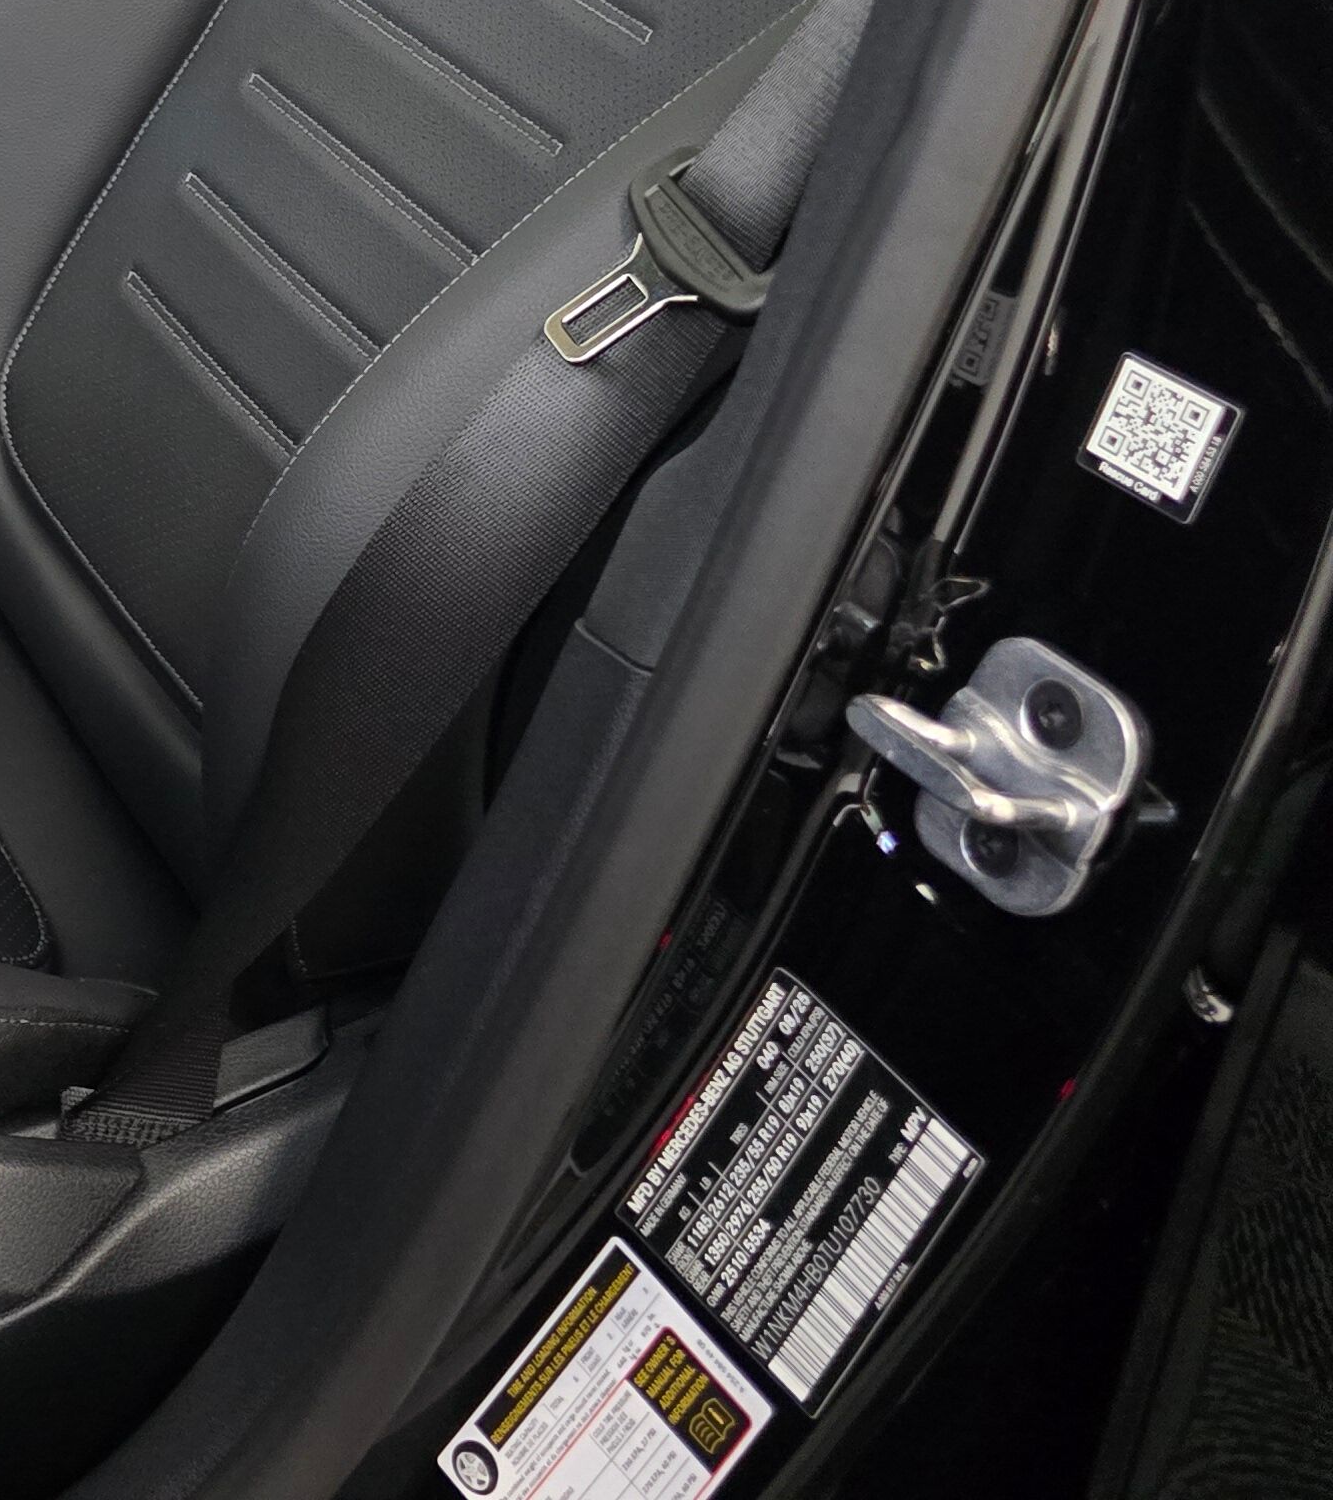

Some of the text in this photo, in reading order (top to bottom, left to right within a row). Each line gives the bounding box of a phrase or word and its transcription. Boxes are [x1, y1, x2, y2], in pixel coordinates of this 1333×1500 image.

[1097, 460, 1158, 502] Rescue Card
[754, 1037, 781, 1072] 040
[626, 980, 788, 1216] MFD BY MERCEDES-BENZ AG STUTTGART
[677, 1203, 692, 1222] KG
[729, 1120, 749, 1146] TIRES
[763, 1075, 779, 1095] RIM
[772, 1060, 789, 1081] SIZE
[786, 1033, 807, 1060] COLD
[685, 1211, 714, 1249] 1185
[706, 1180, 735, 1219] 2612
[727, 1135, 767, 1189] 235/55
[756, 1112, 782, 1144] R19
[801, 1018, 845, 1076] 250(37)
[703, 1229, 732, 1268] 1350
[723, 1198, 753, 1237] 2976
[744, 1153, 785, 1207] 255/50
[774, 1129, 799, 1162] R19
[819, 1036, 863, 1093] 270(40)
[653, 1203, 665, 1218] IN
[658, 1170, 688, 1210] GERMANY
[720, 1088, 880, 1324] THIS VEHICLE CONFORMS TO ALL APPLICABLE FEDERAL MOTOR VEHICLE
[729, 1302, 753, 1334] SAFETY
[745, 1286, 763, 1309] AND
[756, 1266, 777, 1293] THEFT
[769, 1224, 804, 1273] PREVENTION
[829, 1150, 854, 1182] EFFECT
[846, 1139, 861, 1158] ON
[854, 1125, 871, 1146] THE
[863, 1107, 883, 1132] DATE
[875, 1096, 890, 1114] OF
[638, 1210, 660, 1239] MADE
[719, 1247, 749, 1288] 2510
[741, 1214, 772, 1255] 5534
[750, 1172, 883, 1363] W1NKM4HB0TU107730
[899, 1104, 929, 1142] MPV
[691, 1268, 711, 1294] REAR
[489, 1261, 636, 1446] RENSEIGNEMENTS SUR LES PNEUS ET LE CHARGEMENT
[506, 1284, 598, 1399] TIRE AND LOADING INFORMATION
[645, 1346, 687, 1399] MANUAL FOR
[632, 1367, 650, 1388] SEE
[657, 1362, 696, 1411] ADDITIONAL
[666, 1371, 710, 1427] INFORMATION
